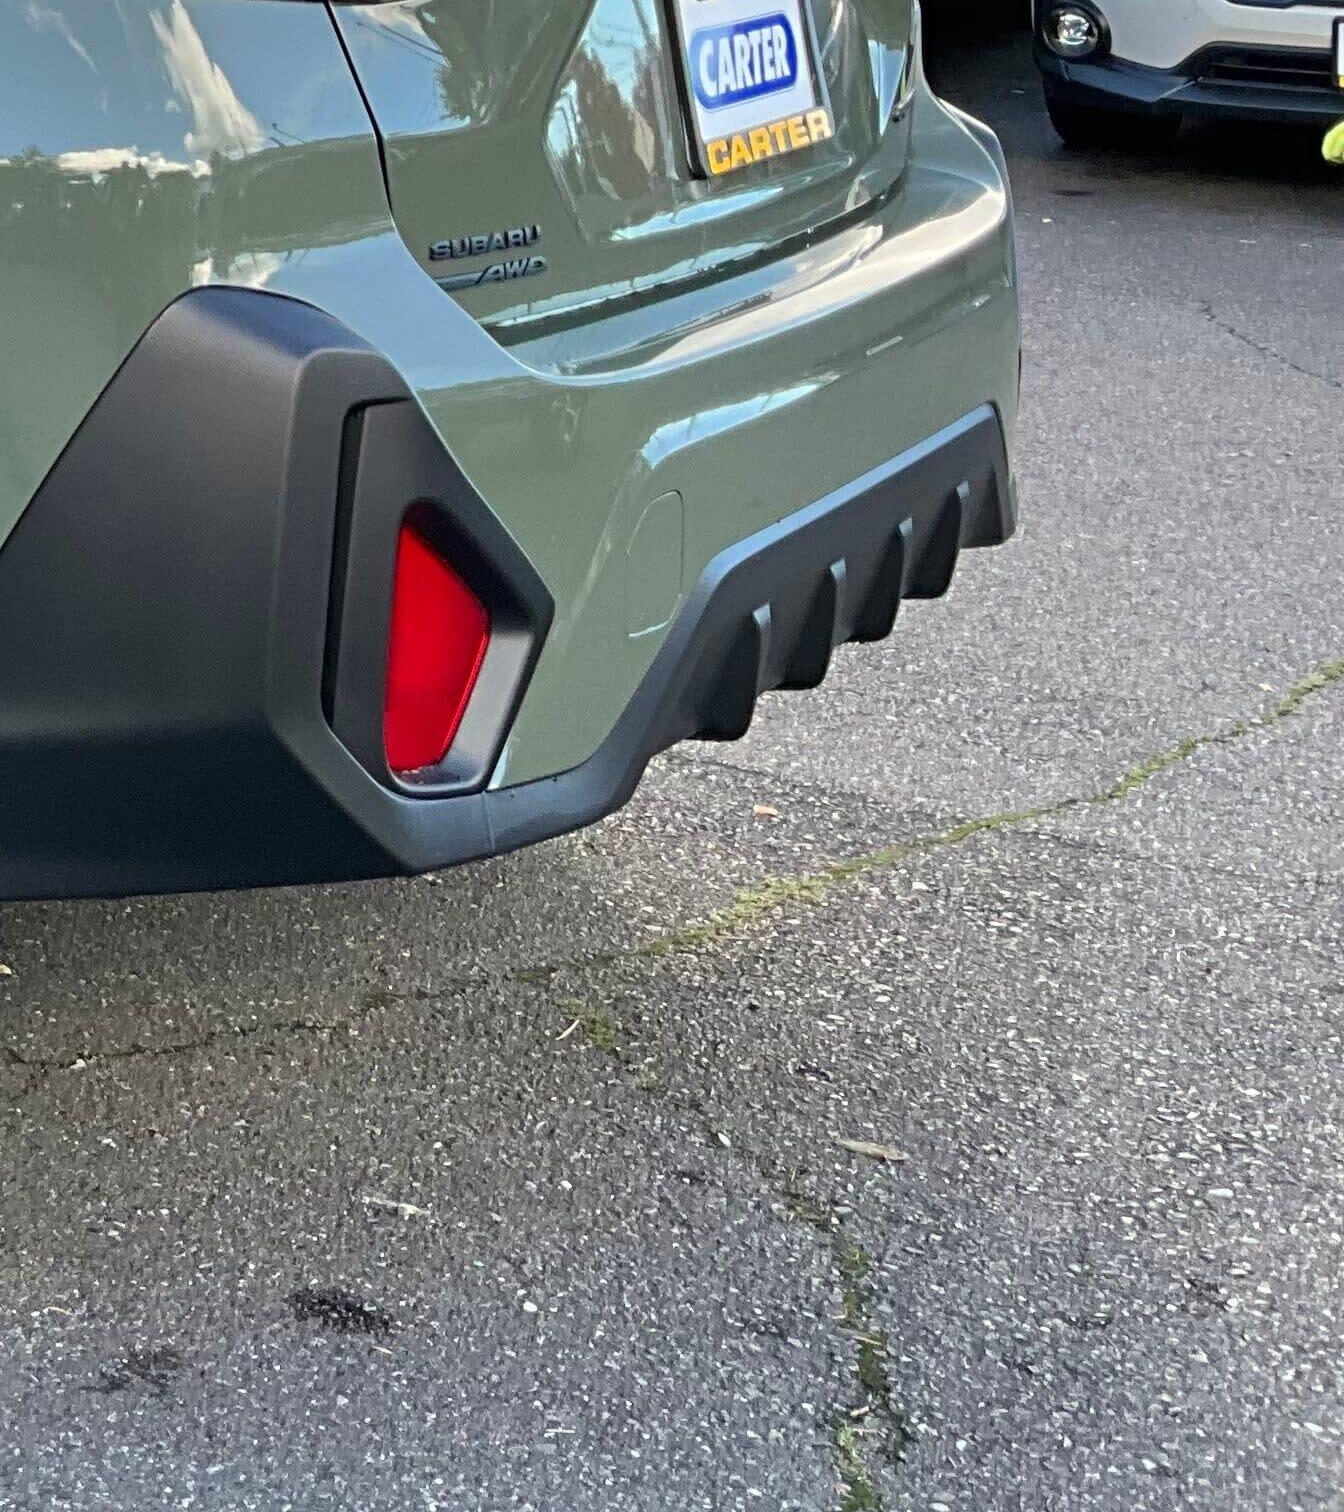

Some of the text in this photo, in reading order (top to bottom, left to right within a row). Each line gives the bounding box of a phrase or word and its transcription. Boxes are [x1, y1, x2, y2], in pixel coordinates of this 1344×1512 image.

[699, 24, 791, 97] CARTER
[707, 109, 832, 175] CARTER
[429, 224, 541, 260] SUBARU
[476, 255, 546, 283] AWD
